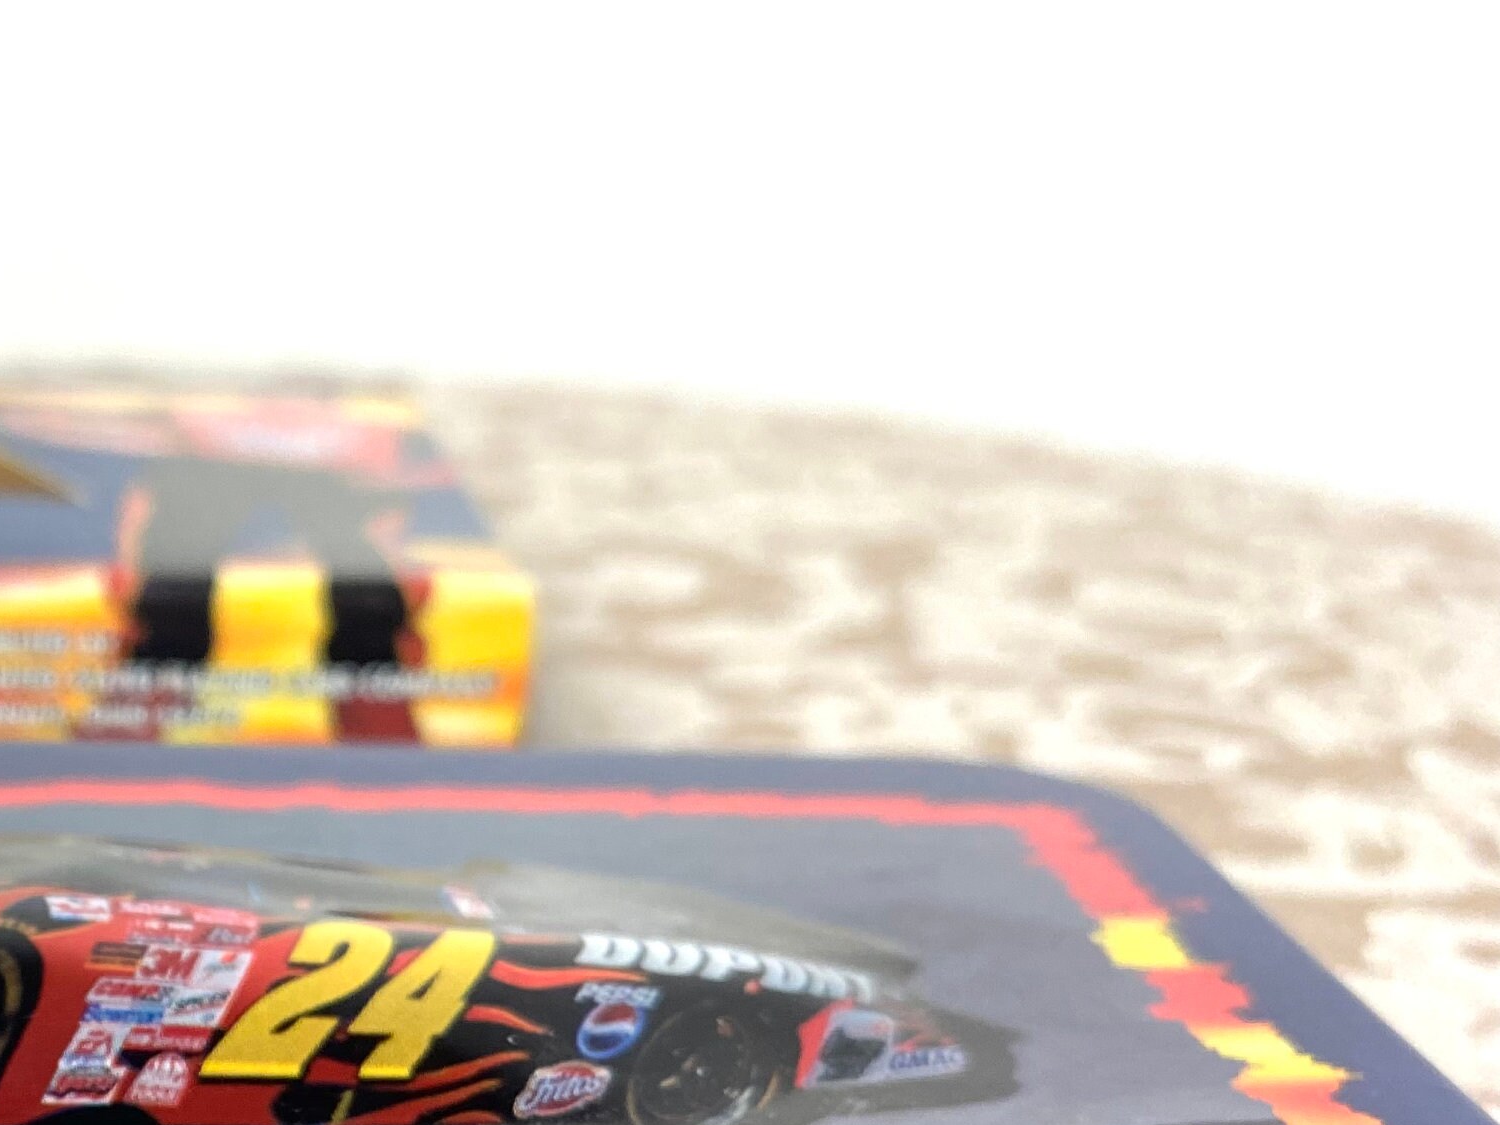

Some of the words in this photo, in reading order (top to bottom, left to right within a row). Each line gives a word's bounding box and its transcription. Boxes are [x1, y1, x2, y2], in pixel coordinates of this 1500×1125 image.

[198, 919, 497, 1080] 24
[575, 982, 663, 1009] PEPSI
[520, 1070, 602, 1110] Fritos
